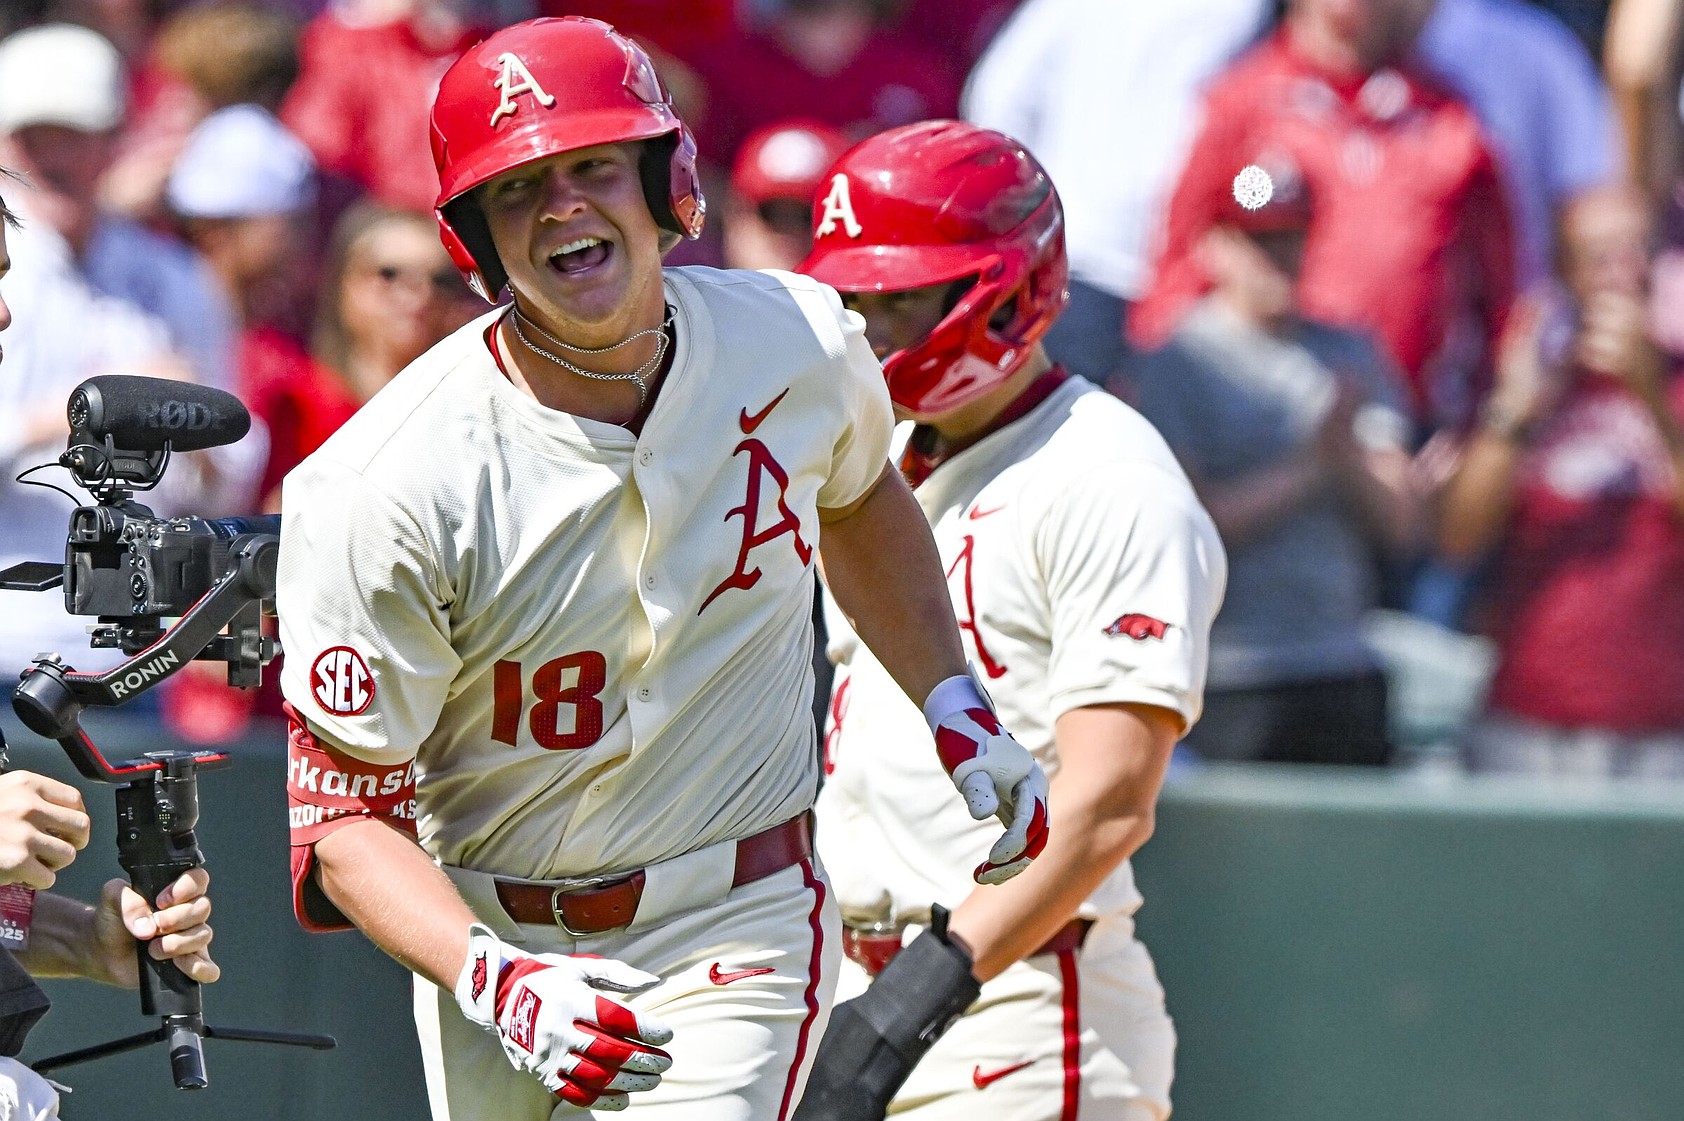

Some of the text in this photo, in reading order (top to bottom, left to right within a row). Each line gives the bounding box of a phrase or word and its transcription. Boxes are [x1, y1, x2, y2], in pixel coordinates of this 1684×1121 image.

[490, 52, 555, 127] A
[814, 173, 863, 240] A
[698, 438, 813, 616] A
[110, 650, 180, 699] RONIN
[315, 651, 369, 712] SEC
[491, 651, 607, 750] 18
